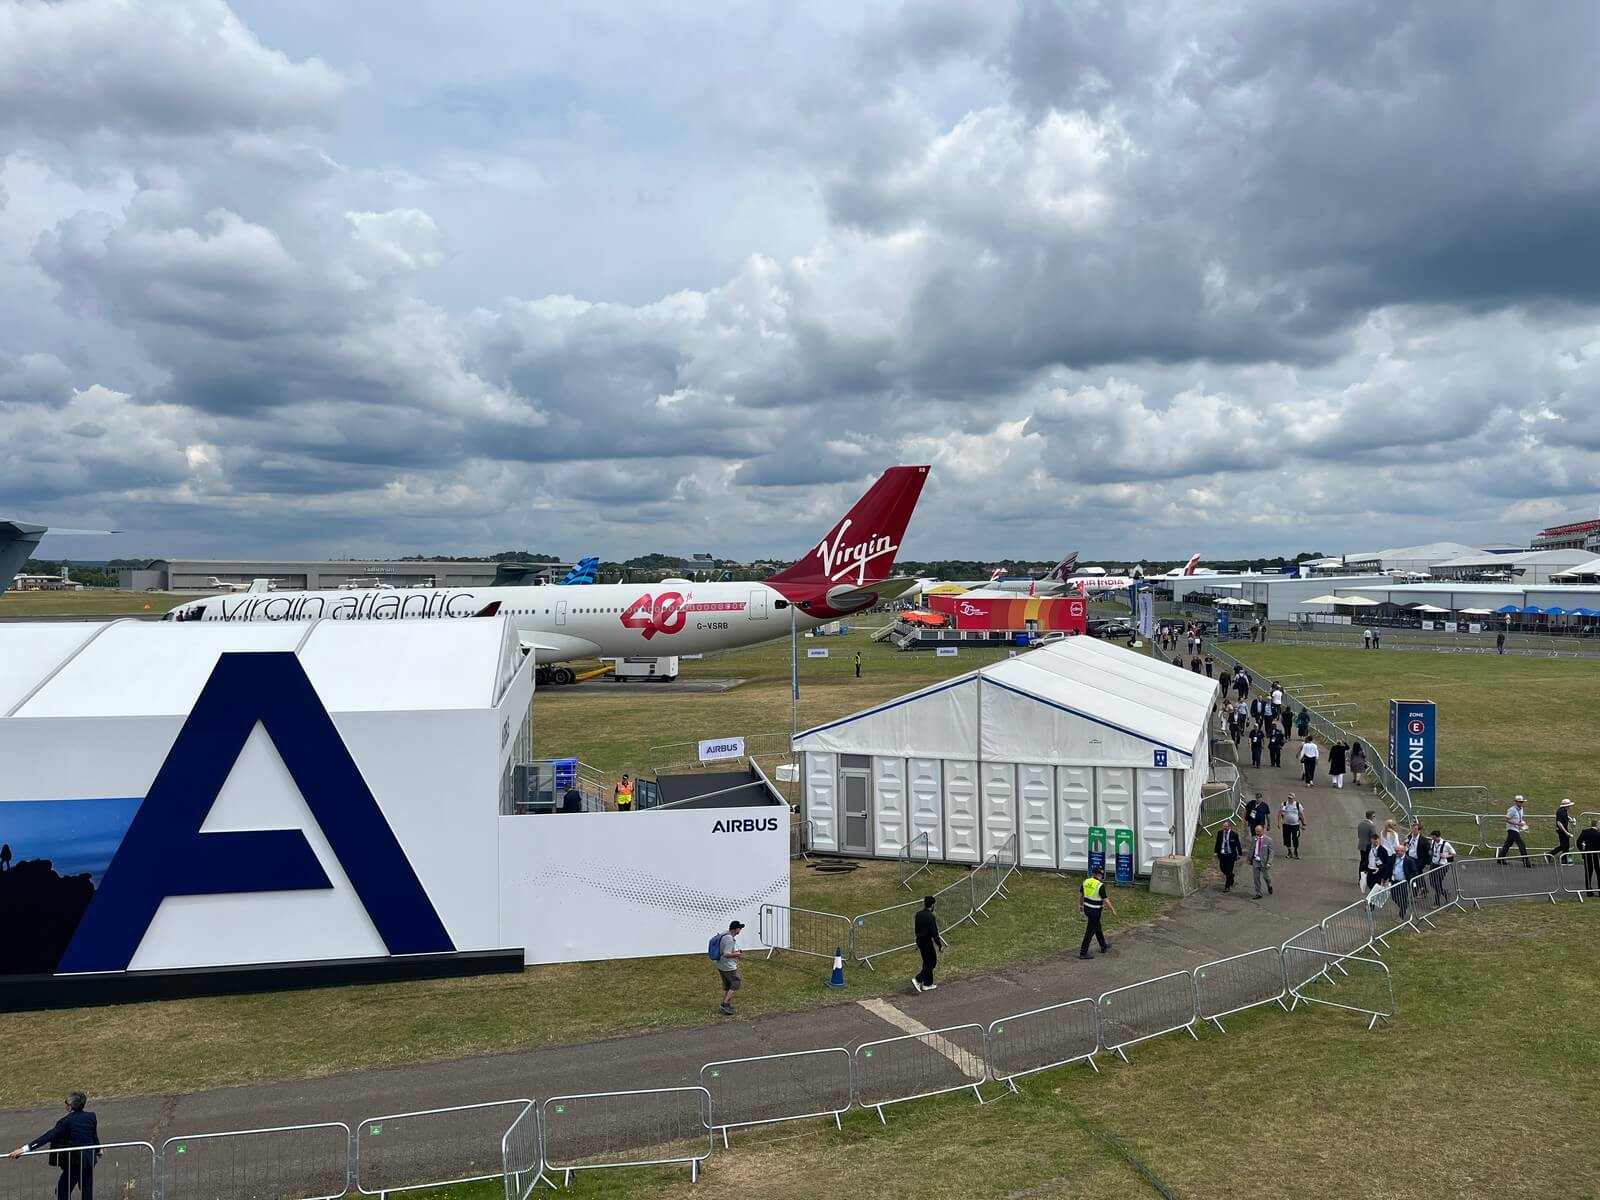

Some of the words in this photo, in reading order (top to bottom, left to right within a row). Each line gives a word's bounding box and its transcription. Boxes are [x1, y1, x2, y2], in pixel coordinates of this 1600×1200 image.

[816, 519, 898, 585] Virgin
[332, 590, 475, 620] atlantic
[696, 622, 729, 630] G-VSRB
[1413, 723, 1420, 732] E
[706, 743, 738, 754] AIRBUS
[1409, 737, 1424, 783] ZONE
[52, 652, 458, 975] A
[711, 818, 778, 833] AIRBUS
